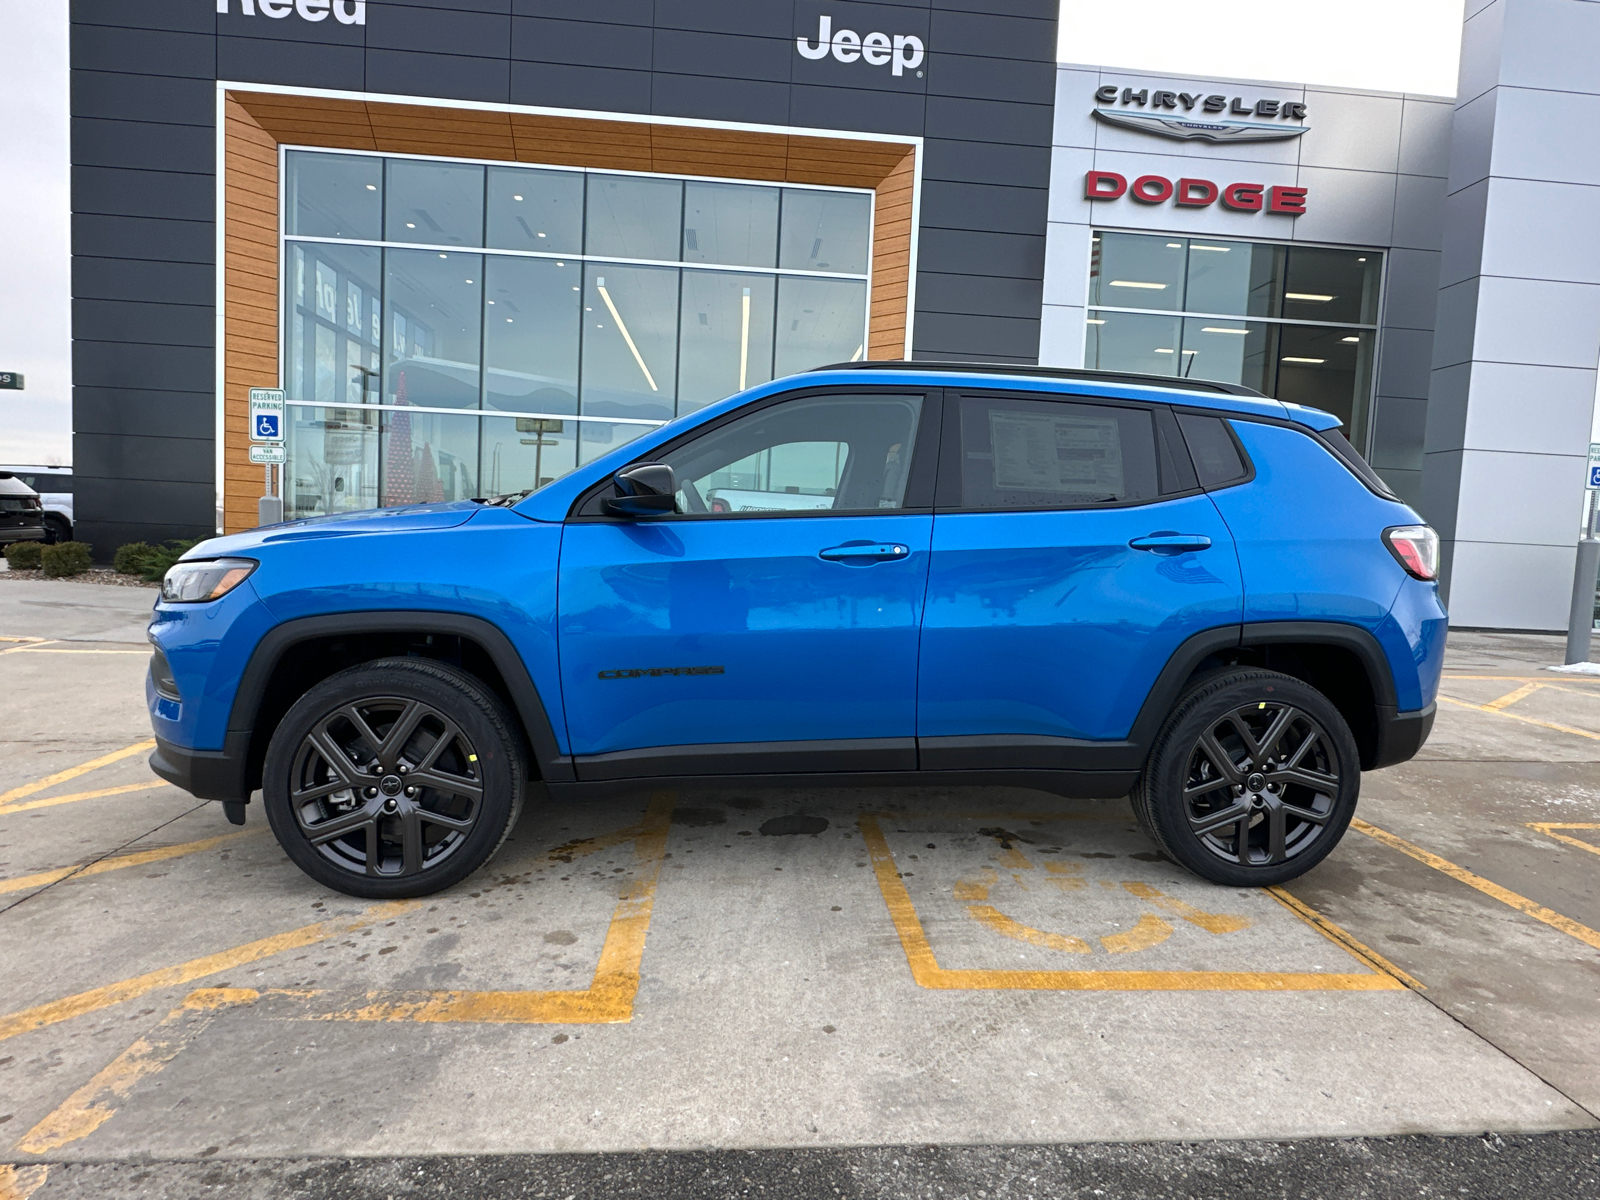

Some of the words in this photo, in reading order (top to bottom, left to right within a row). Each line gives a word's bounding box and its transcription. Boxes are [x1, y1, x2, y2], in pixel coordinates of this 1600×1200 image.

[796, 15, 925, 77] Jeep
[1095, 85, 1308, 118] CHRYSLER
[1085, 170, 1308, 216] DODGE
[252, 392, 282, 401] RESERVED
[252, 402, 283, 411] PARKING
[598, 666, 725, 679] COMPASS
